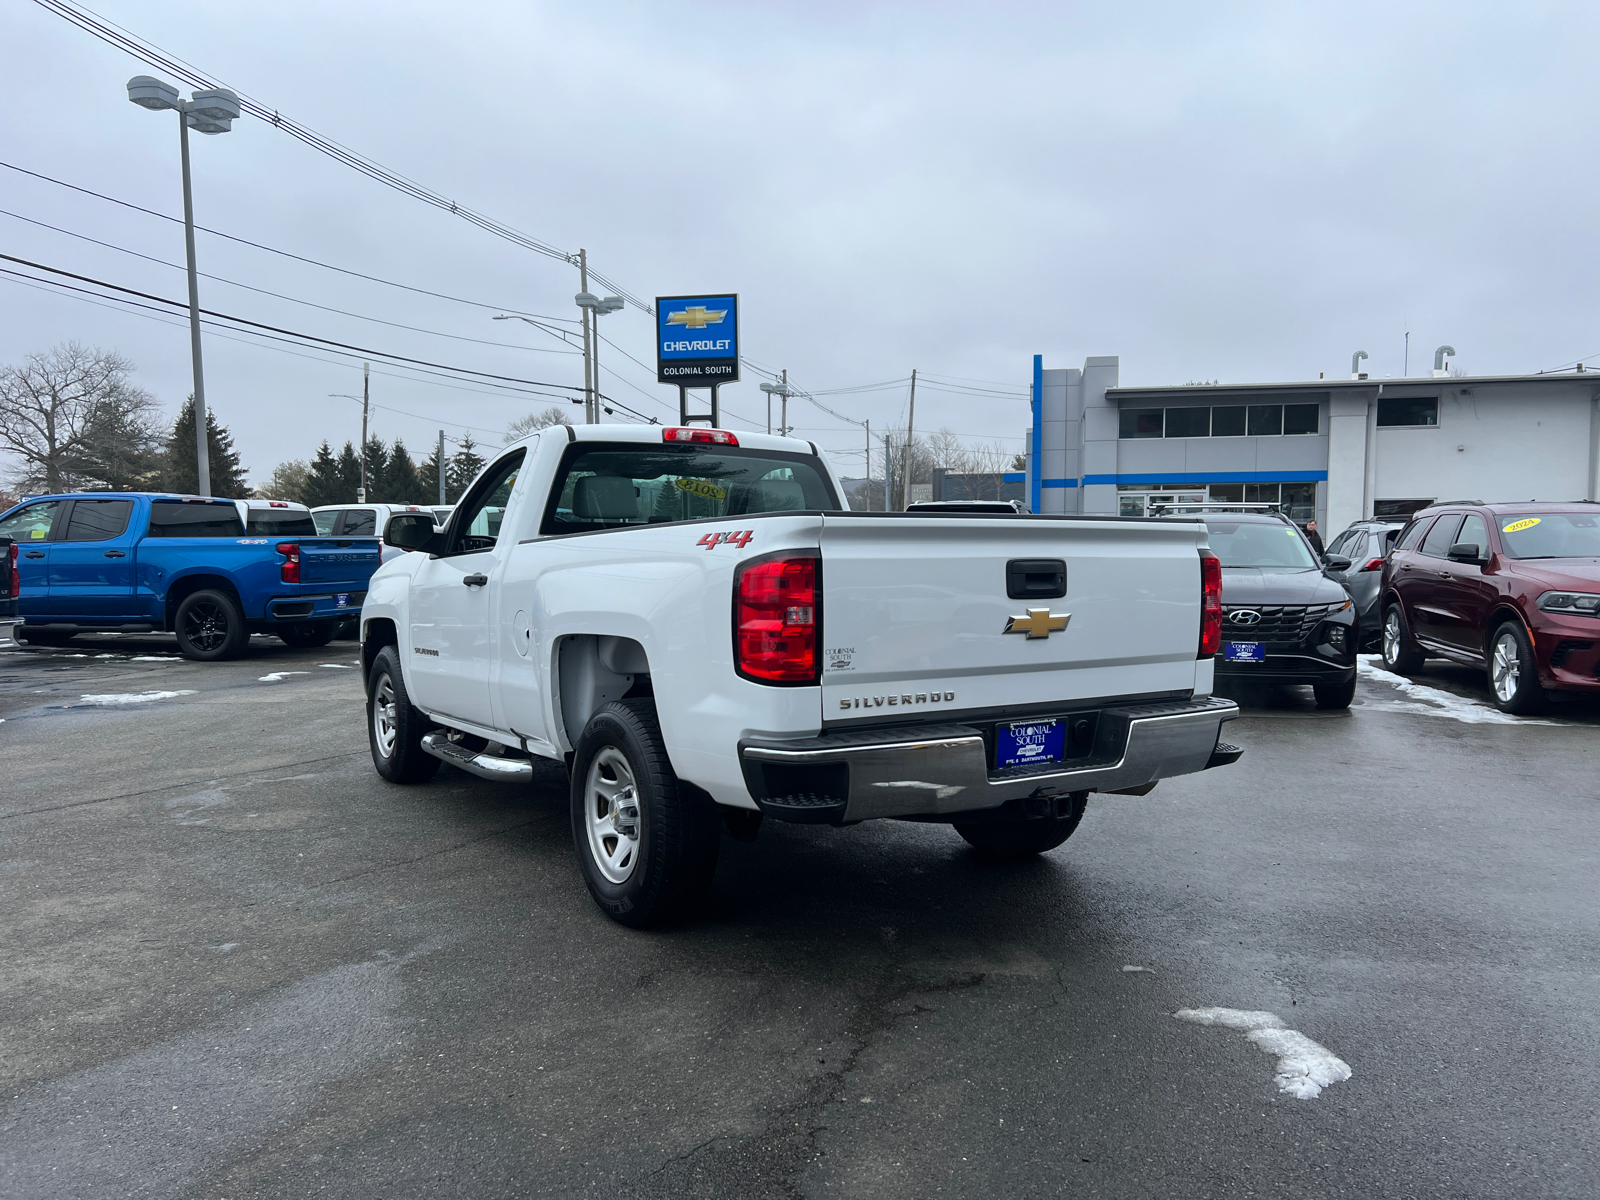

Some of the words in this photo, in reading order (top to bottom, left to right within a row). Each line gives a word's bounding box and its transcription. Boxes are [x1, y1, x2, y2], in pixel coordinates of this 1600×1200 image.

[663, 340, 731, 352] CHEVROLET
[664, 367, 703, 375] COLONIAL
[705, 366, 732, 374] SOUTH
[1510, 519, 1535, 530] 2024
[308, 553, 378, 563] CHEVROLET
[825, 647, 857, 655] COLONIAL
[830, 653, 852, 661] SOUTH
[840, 690, 956, 710] SILVERADO
[1010, 725, 1052, 737] COLONIAL
[1016, 734, 1045, 746] SOUTH
